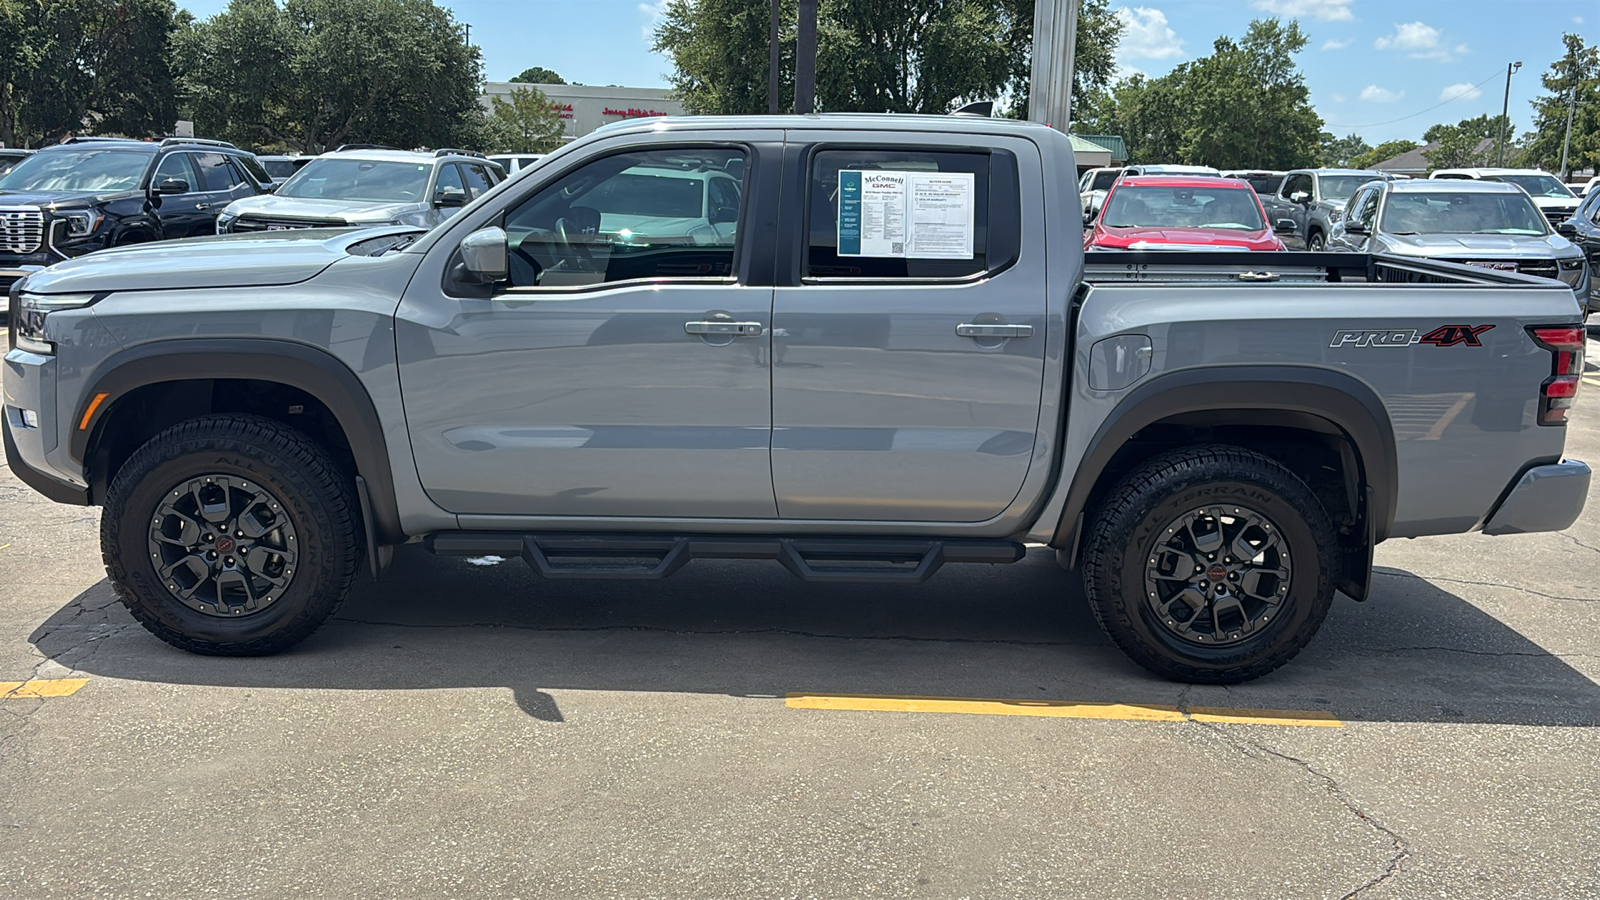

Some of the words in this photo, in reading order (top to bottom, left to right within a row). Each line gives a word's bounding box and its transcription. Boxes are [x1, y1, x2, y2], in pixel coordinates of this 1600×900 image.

[864, 175, 904, 185] McConnell
[214, 457, 257, 473] ALL
[1137, 514, 1163, 550] ALL
[1168, 486, 1273, 508] TERRAIN
